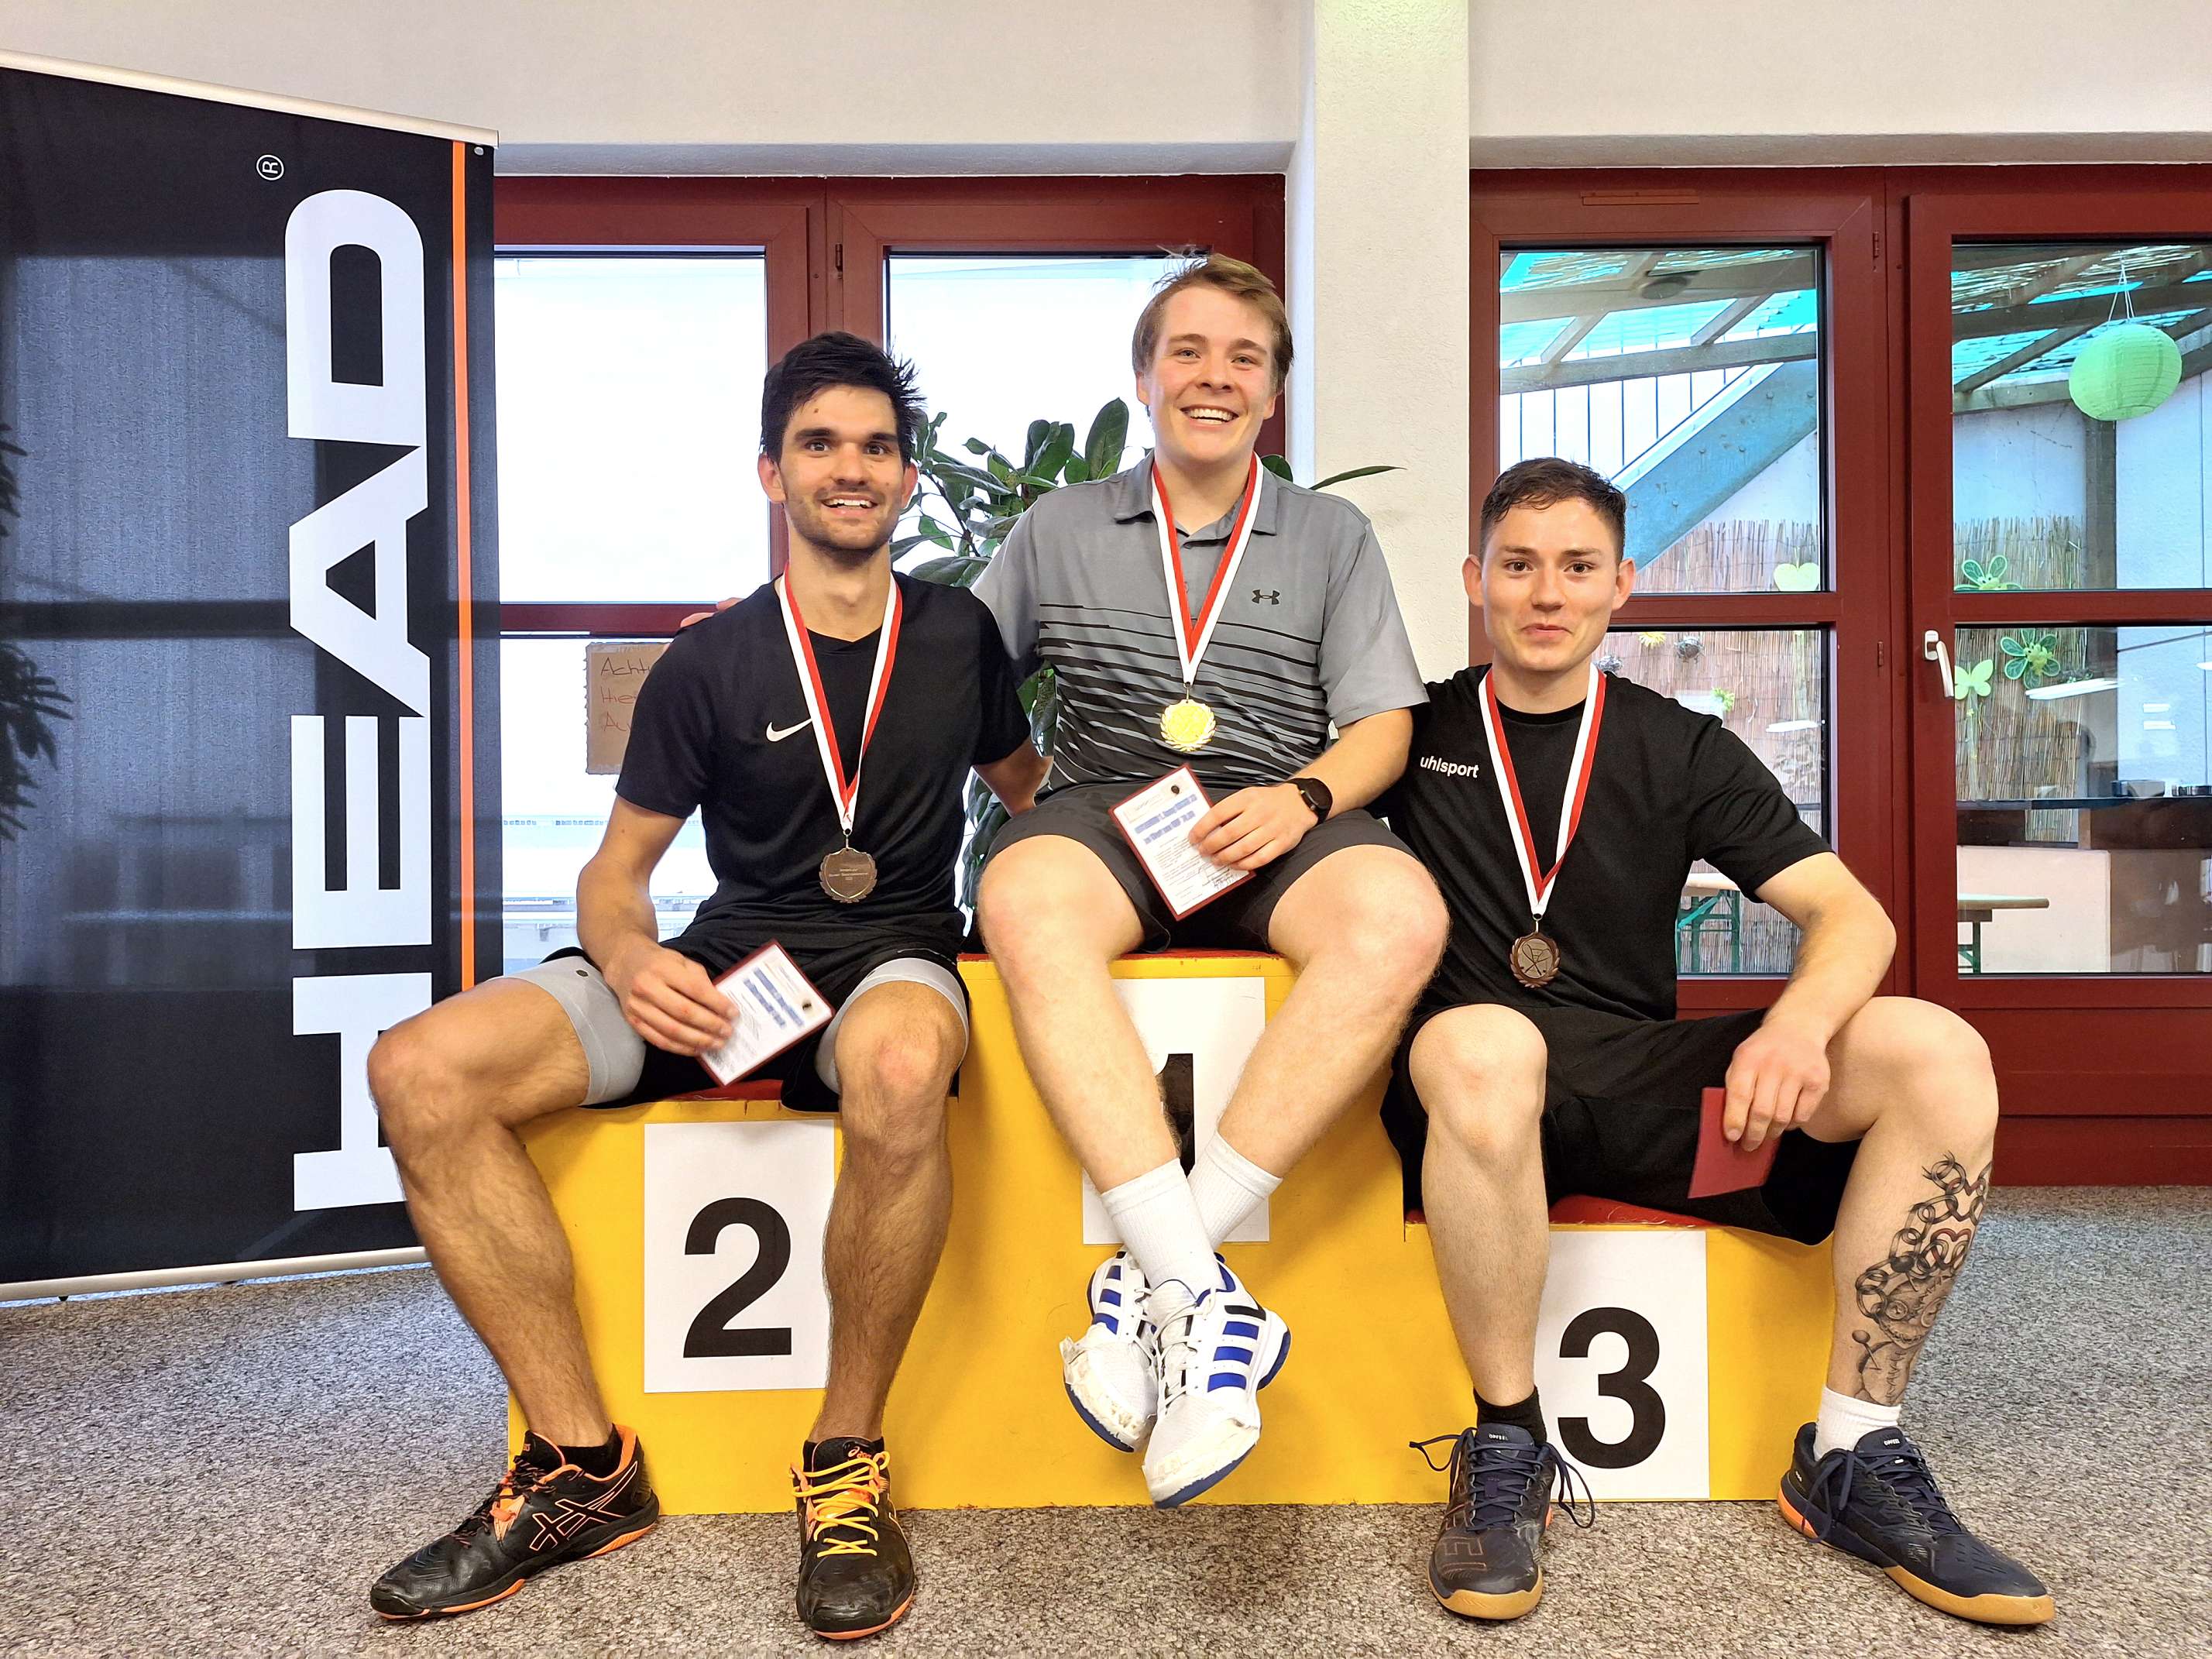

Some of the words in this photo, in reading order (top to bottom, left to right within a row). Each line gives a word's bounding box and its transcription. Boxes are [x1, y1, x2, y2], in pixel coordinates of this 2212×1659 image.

[284, 189, 433, 1212] HEAD
[600, 656, 651, 676] Acht
[600, 686, 637, 705] Hie
[1420, 755, 1479, 778] uhlsport
[1155, 1053, 1196, 1178] 1
[682, 1197, 792, 1358] 2
[1557, 1306, 1666, 1470] 3
